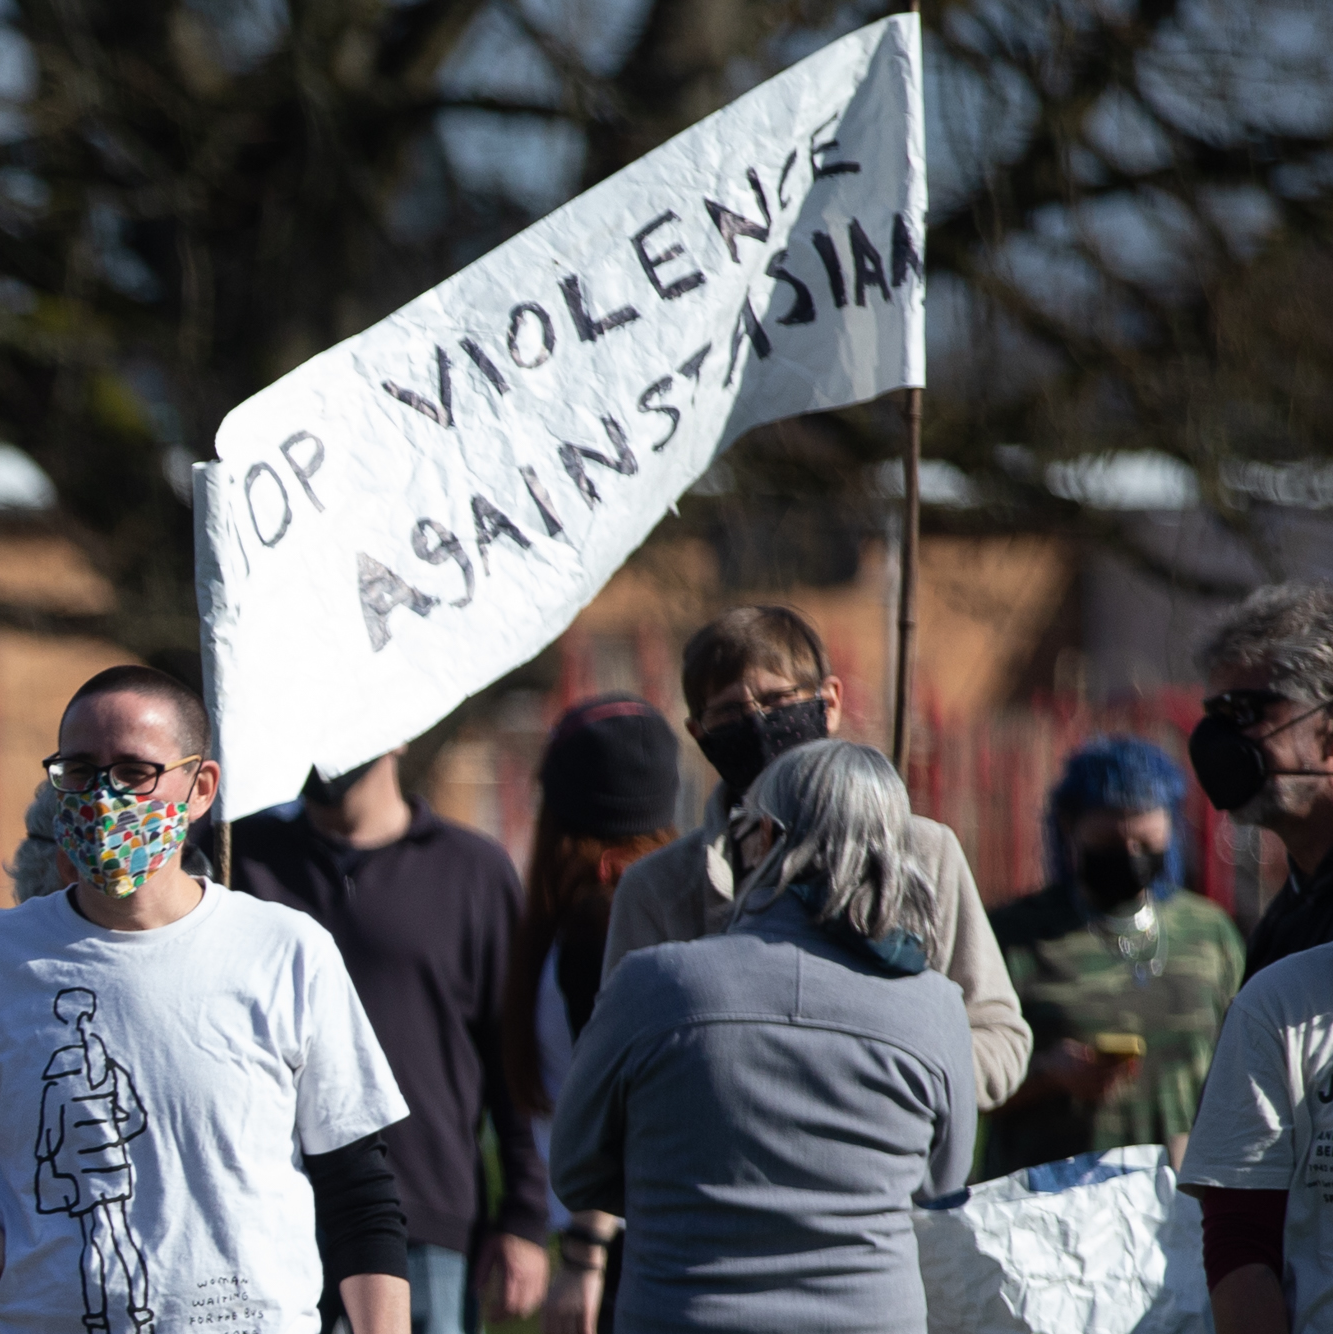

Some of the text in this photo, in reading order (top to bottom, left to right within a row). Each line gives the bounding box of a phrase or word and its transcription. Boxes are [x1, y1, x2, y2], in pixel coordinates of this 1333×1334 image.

[192, 1291, 249, 1307] WAITING
[189, 1313, 213, 1325] FOR
[244, 1307, 264, 1319] BUS
